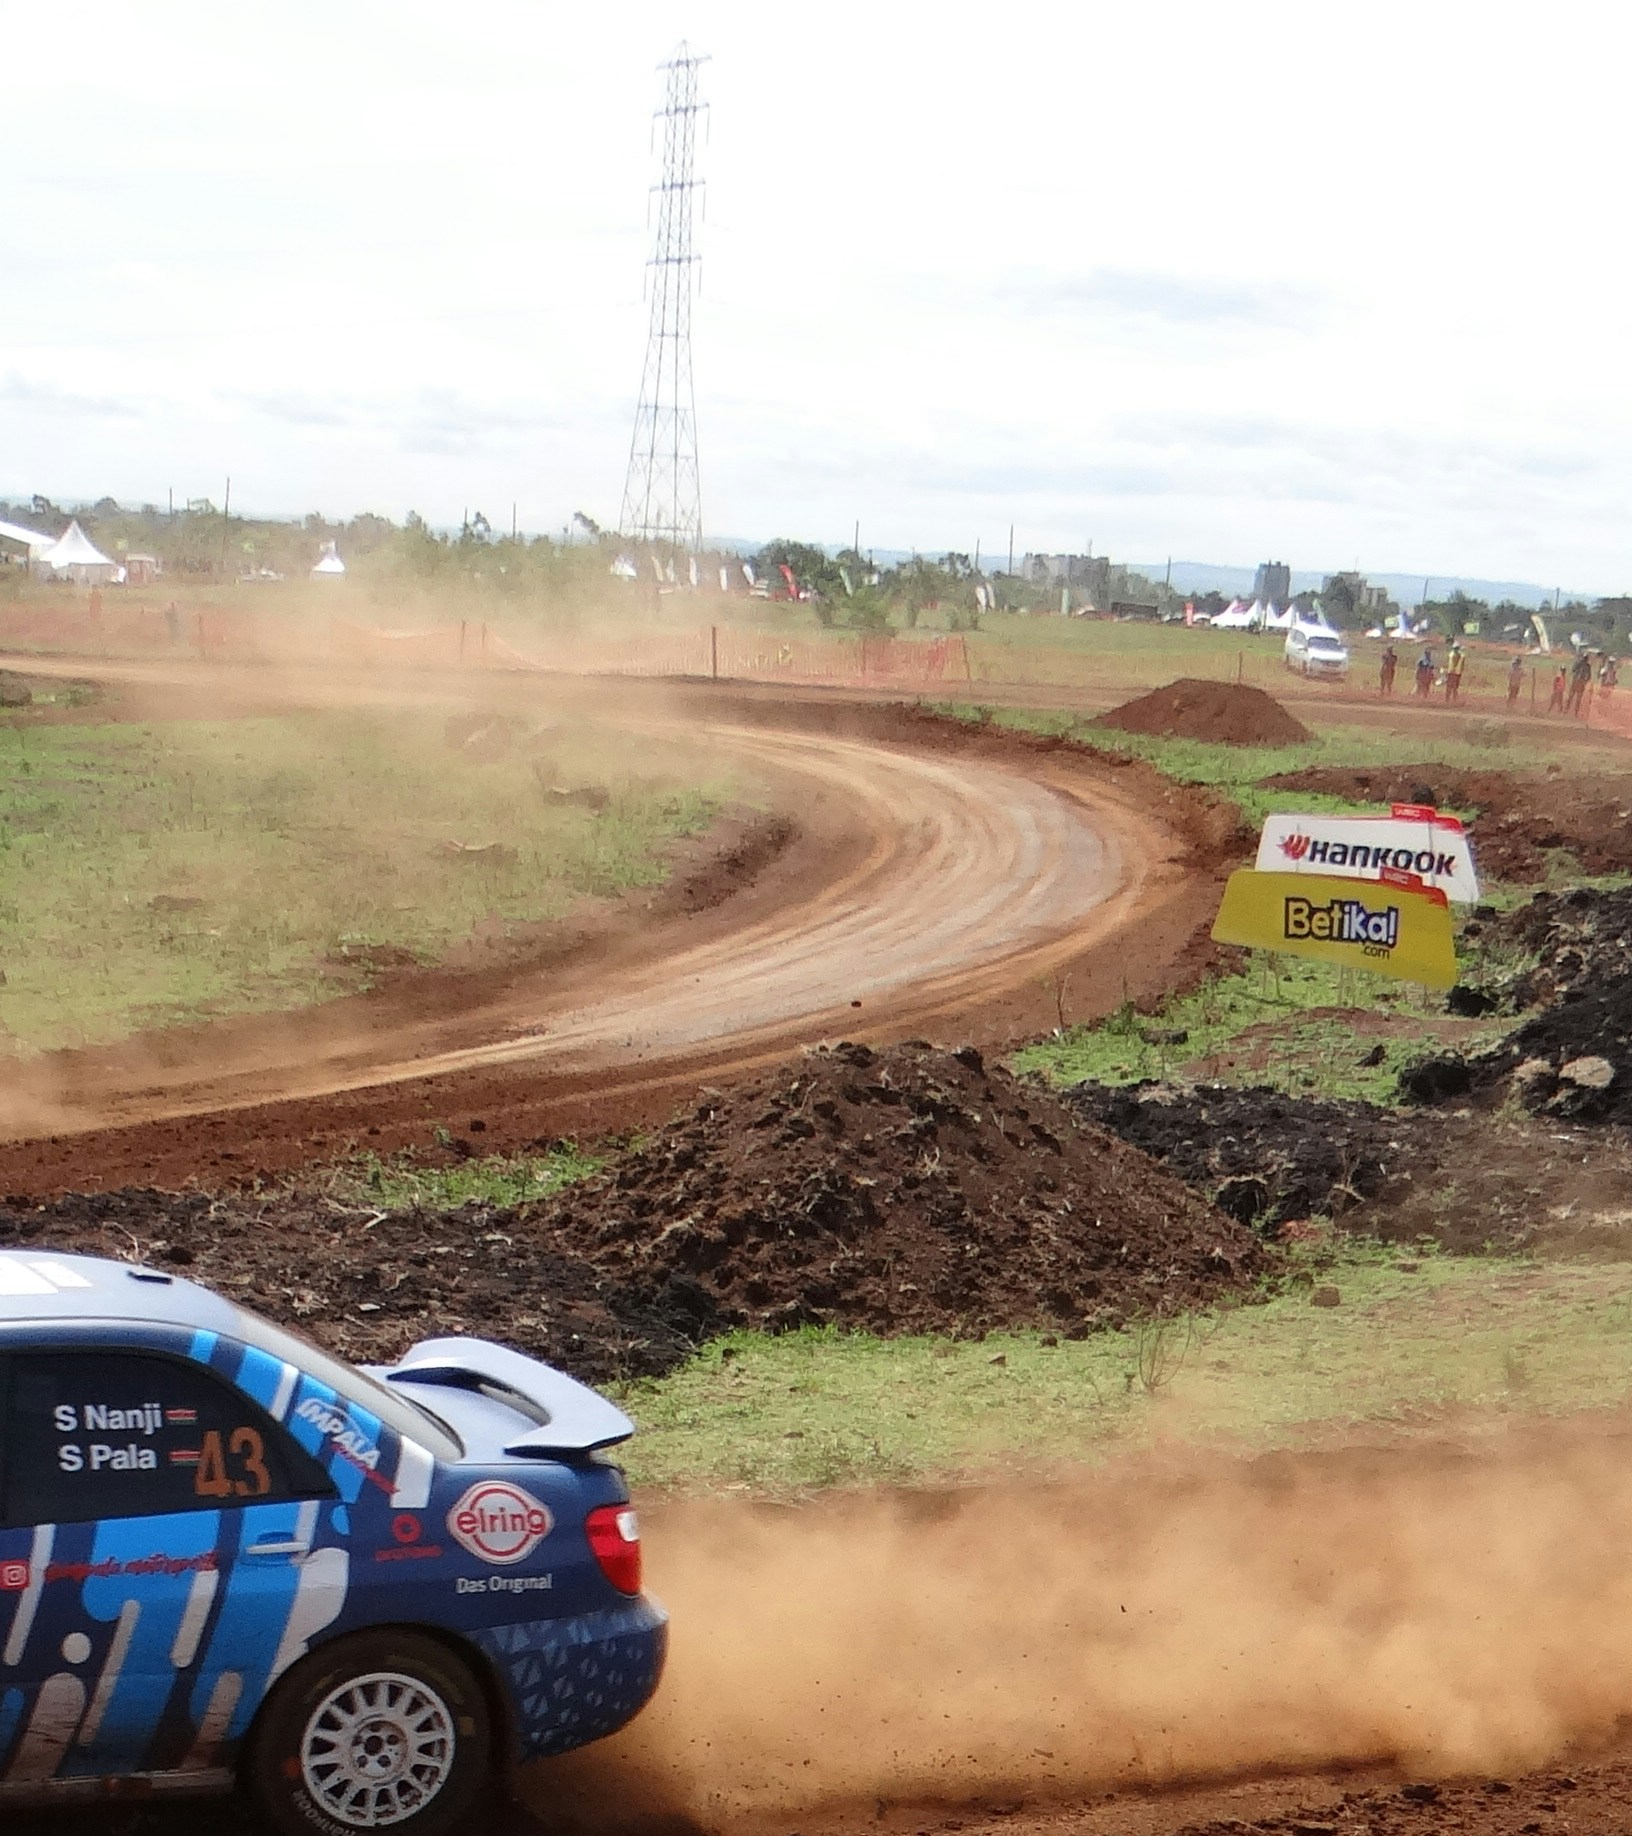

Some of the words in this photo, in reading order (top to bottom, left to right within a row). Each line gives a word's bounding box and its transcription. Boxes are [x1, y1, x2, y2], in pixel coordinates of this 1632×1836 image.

[1285, 897, 1399, 949] Betika!
[1361, 945, 1390, 960] .com
[54, 1404, 78, 1432] S
[84, 1403, 163, 1435] Nanji
[295, 1401, 381, 1470] IMPALA
[58, 1445, 84, 1472] S
[90, 1443, 157, 1470] Pala
[195, 1426, 272, 1497] 43
[457, 1507, 546, 1535] elring
[456, 1578, 487, 1594] Das
[489, 1573, 552, 1593] Original
